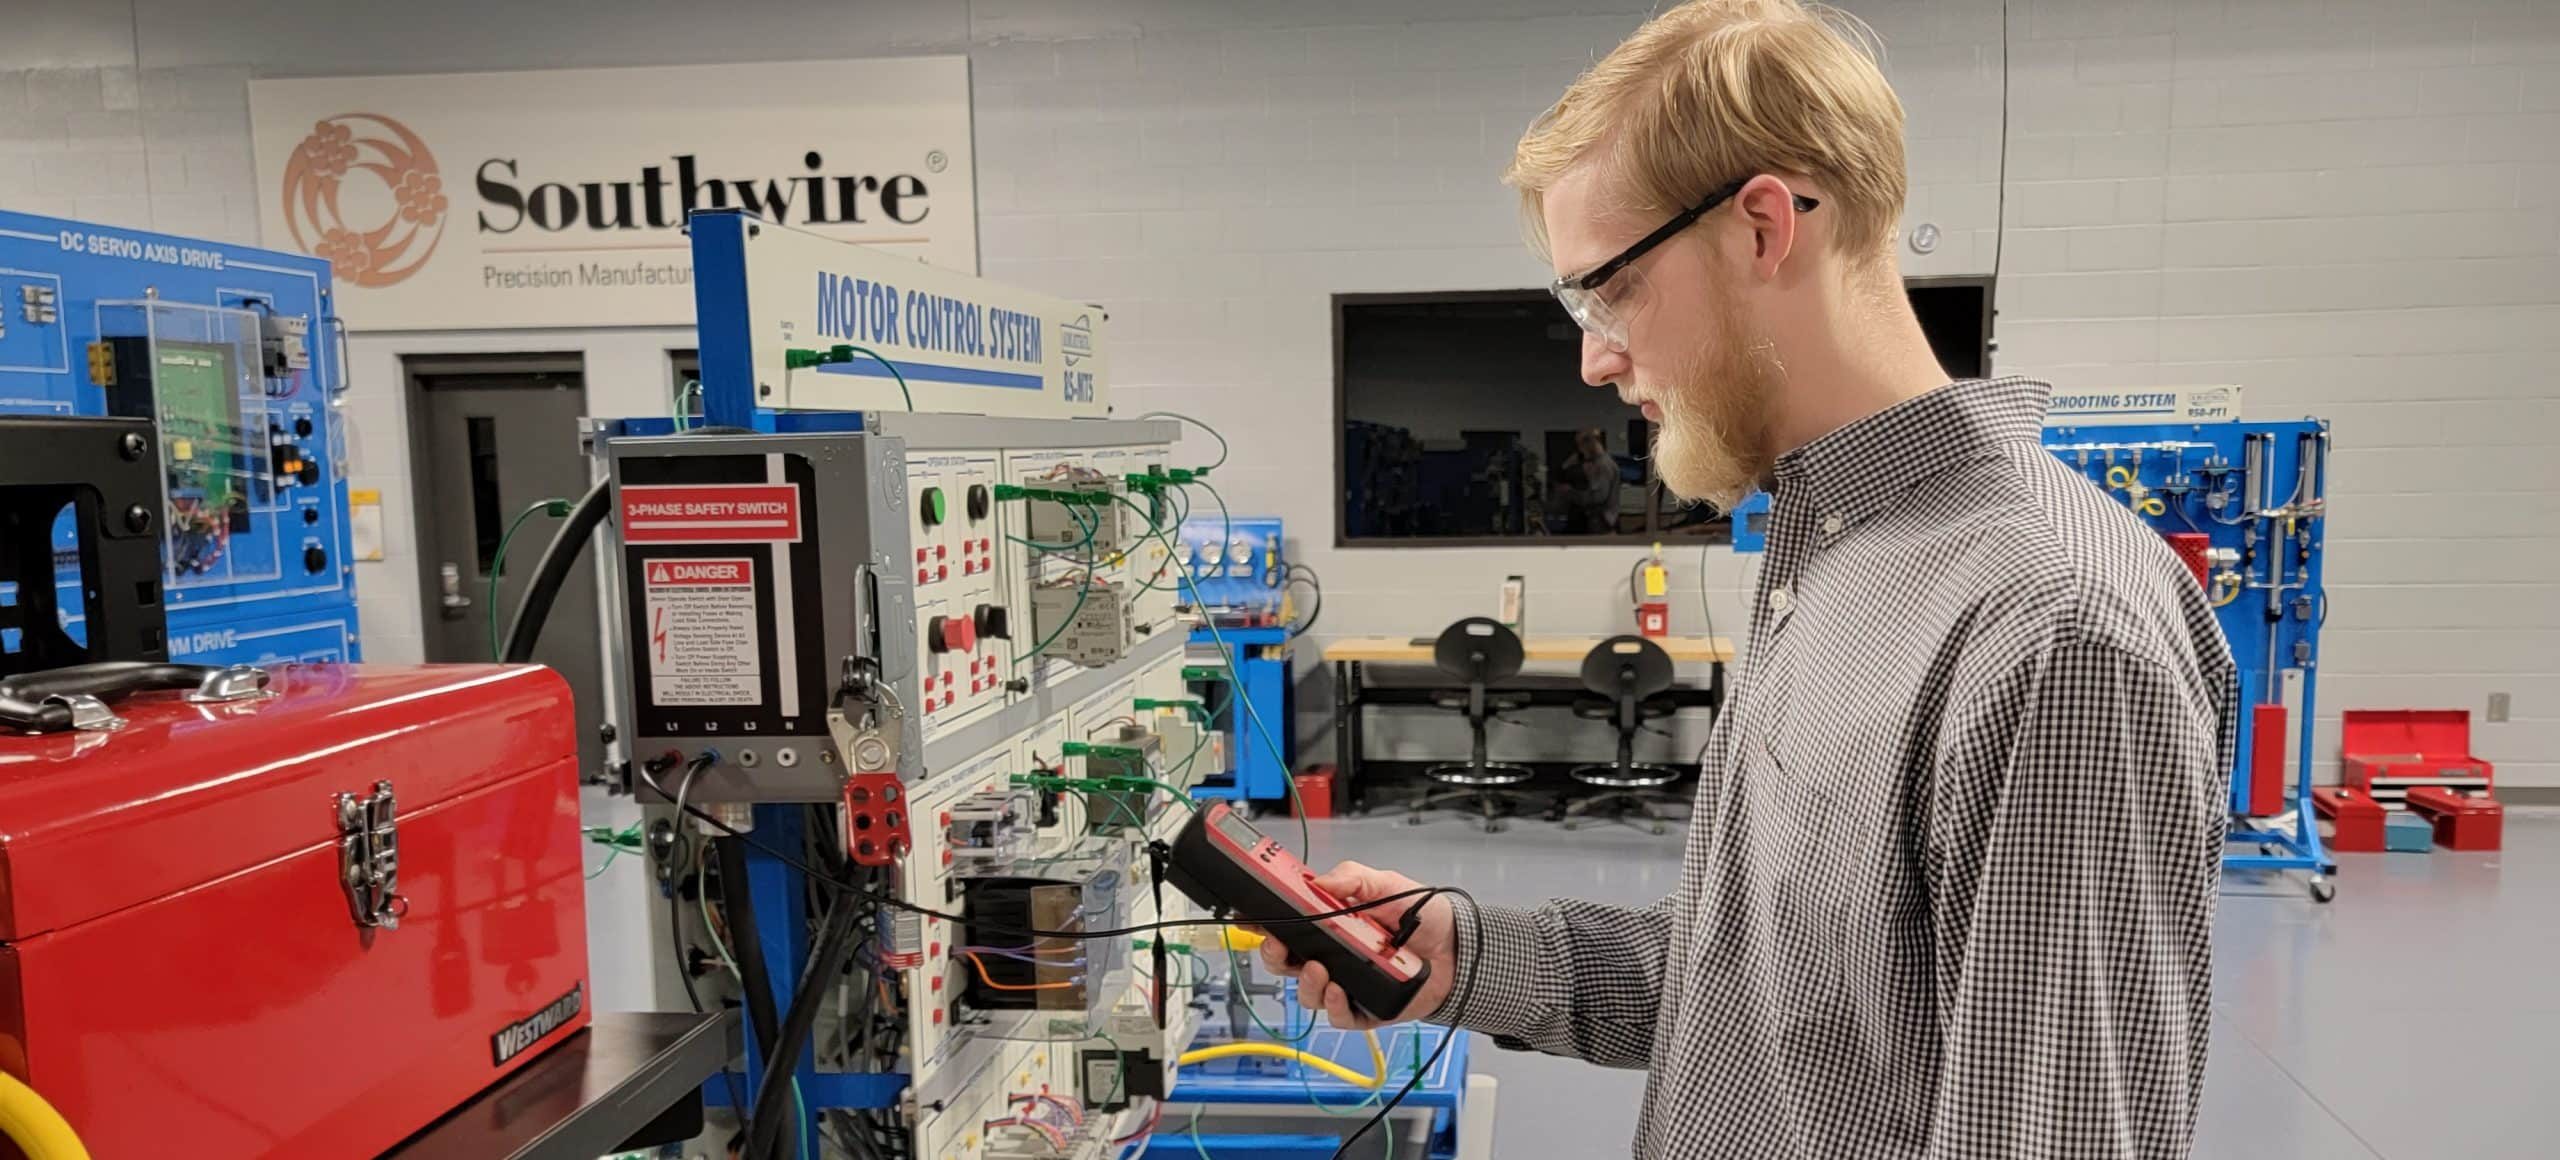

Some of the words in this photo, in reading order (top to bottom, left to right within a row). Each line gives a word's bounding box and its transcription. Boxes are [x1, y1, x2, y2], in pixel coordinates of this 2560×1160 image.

[475, 151, 931, 234] Southwire
[60, 231, 85, 251] DC
[88, 235, 142, 260] SERVO
[144, 242, 178, 265] AXIS
[181, 248, 225, 270] DRIVE
[483, 264, 574, 288] Precision
[817, 270, 899, 346] MOTOR
[906, 289, 985, 357] CONTROL
[989, 307, 1042, 364] SYSTEM
[2124, 393, 2176, 408] SYSTEM
[627, 503, 683, 516] 3-PHASE
[685, 502, 736, 516] SAFETY
[737, 502, 788, 515] SWITCH
[673, 564, 739, 580] DANGER
[193, 629, 237, 653] DRIVE
[666, 722, 679, 731] L1
[705, 721, 719, 731] L2
[744, 721, 757, 731] L3
[785, 721, 794, 731] N
[498, 991, 582, 1061] WESTWARD
